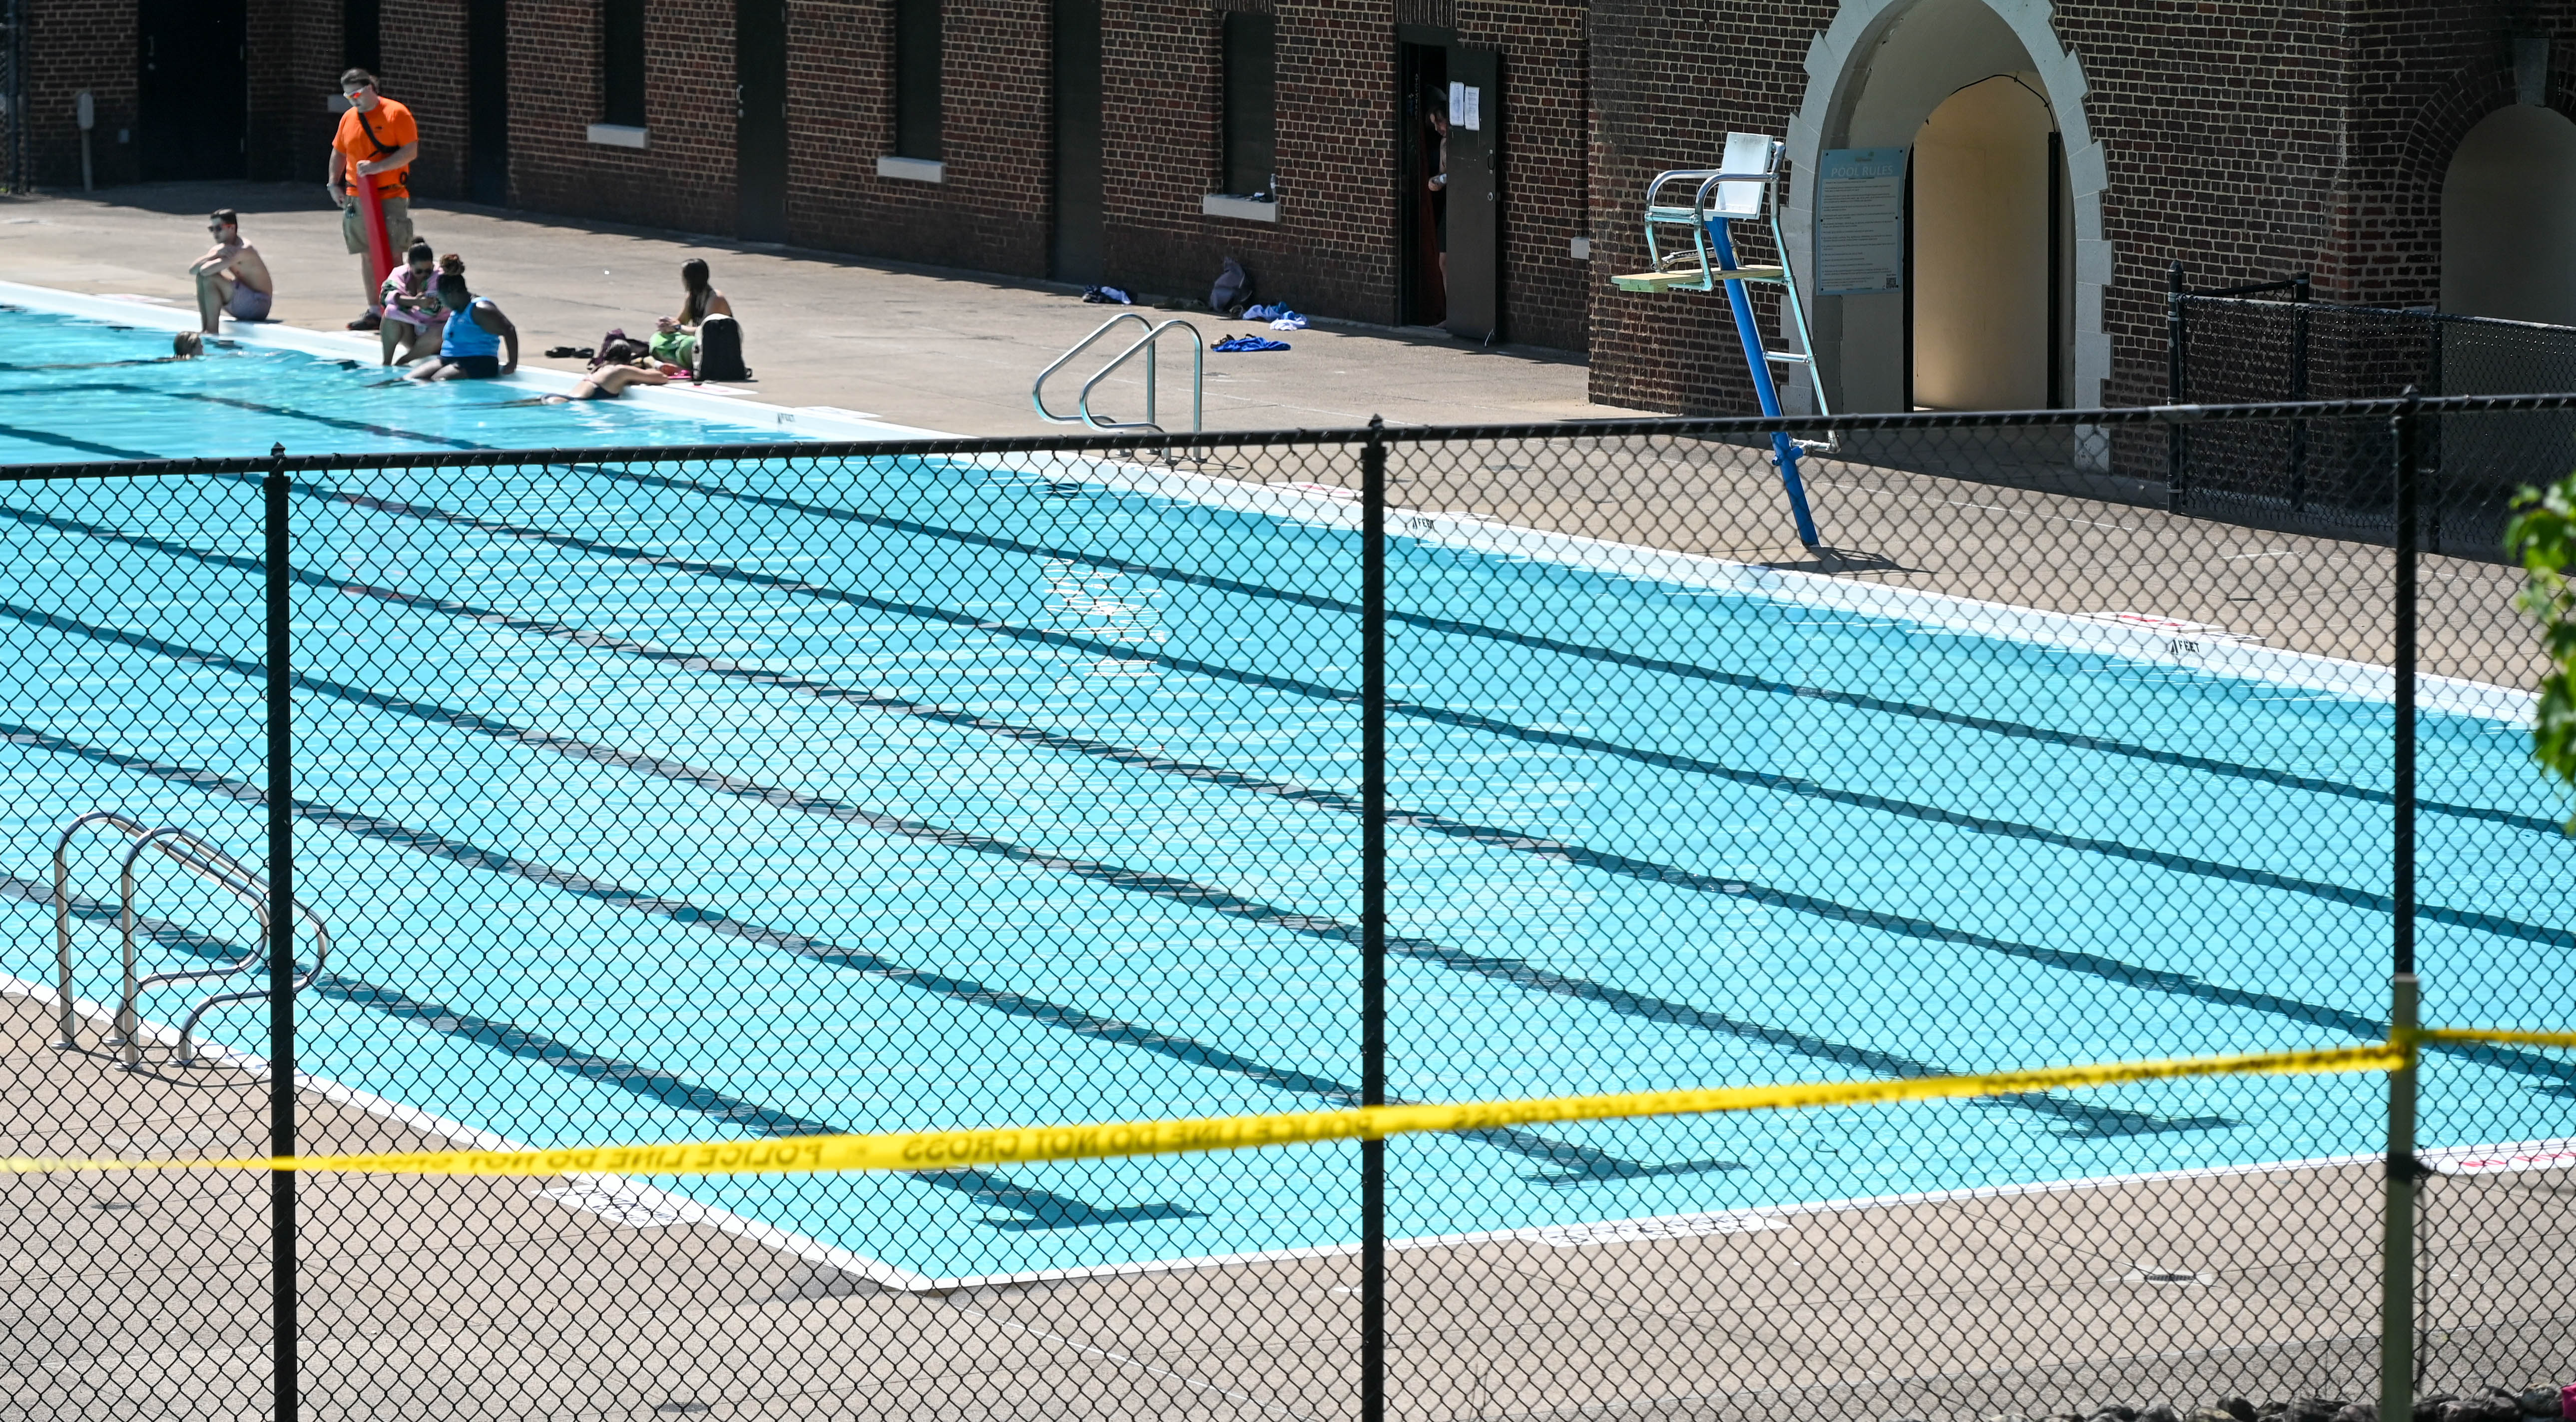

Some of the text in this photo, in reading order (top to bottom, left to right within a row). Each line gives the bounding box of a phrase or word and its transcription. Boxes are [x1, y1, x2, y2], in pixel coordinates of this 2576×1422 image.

[1831, 164, 1894, 177] POOL RULES
[2178, 640, 2200, 653] FEET
